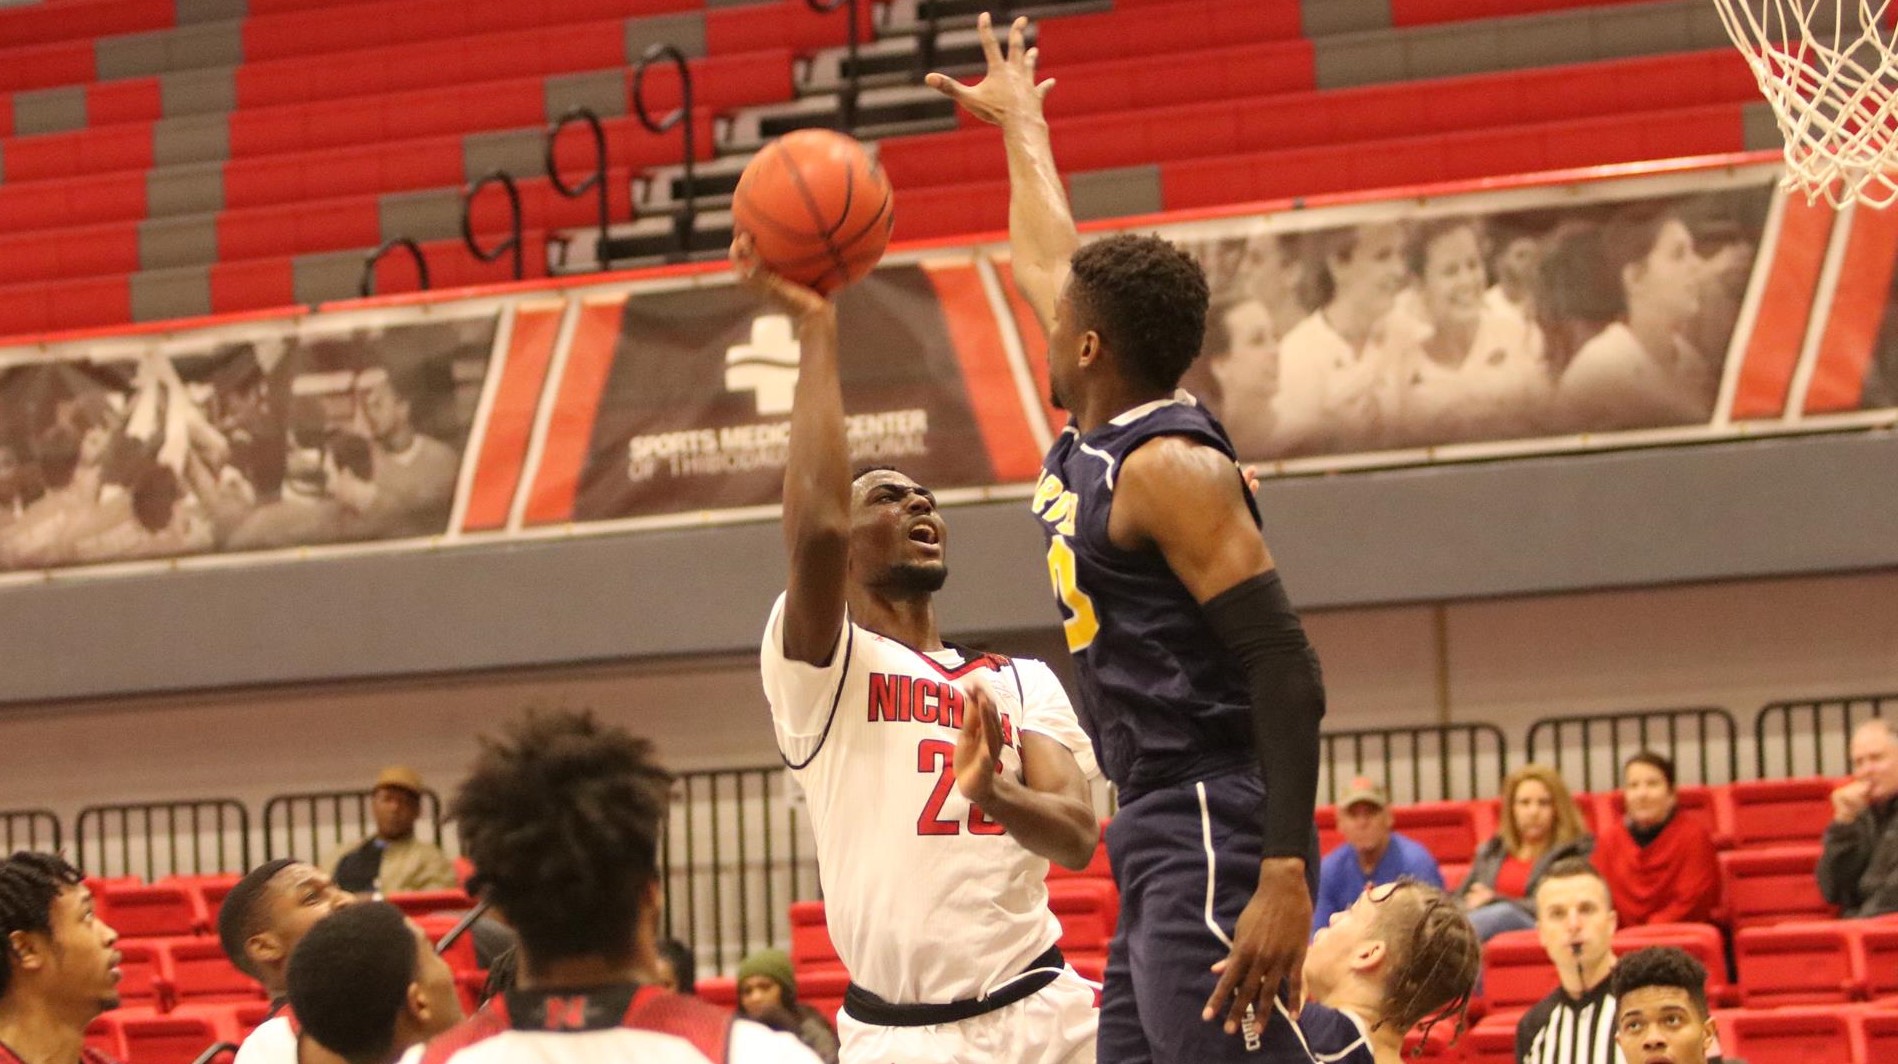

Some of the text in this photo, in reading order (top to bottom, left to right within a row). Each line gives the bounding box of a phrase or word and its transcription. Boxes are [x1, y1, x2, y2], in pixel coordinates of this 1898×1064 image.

[629, 428, 717, 460] SPORTS
[719, 421, 791, 449] MEDIC
[628, 458, 655, 482] OF
